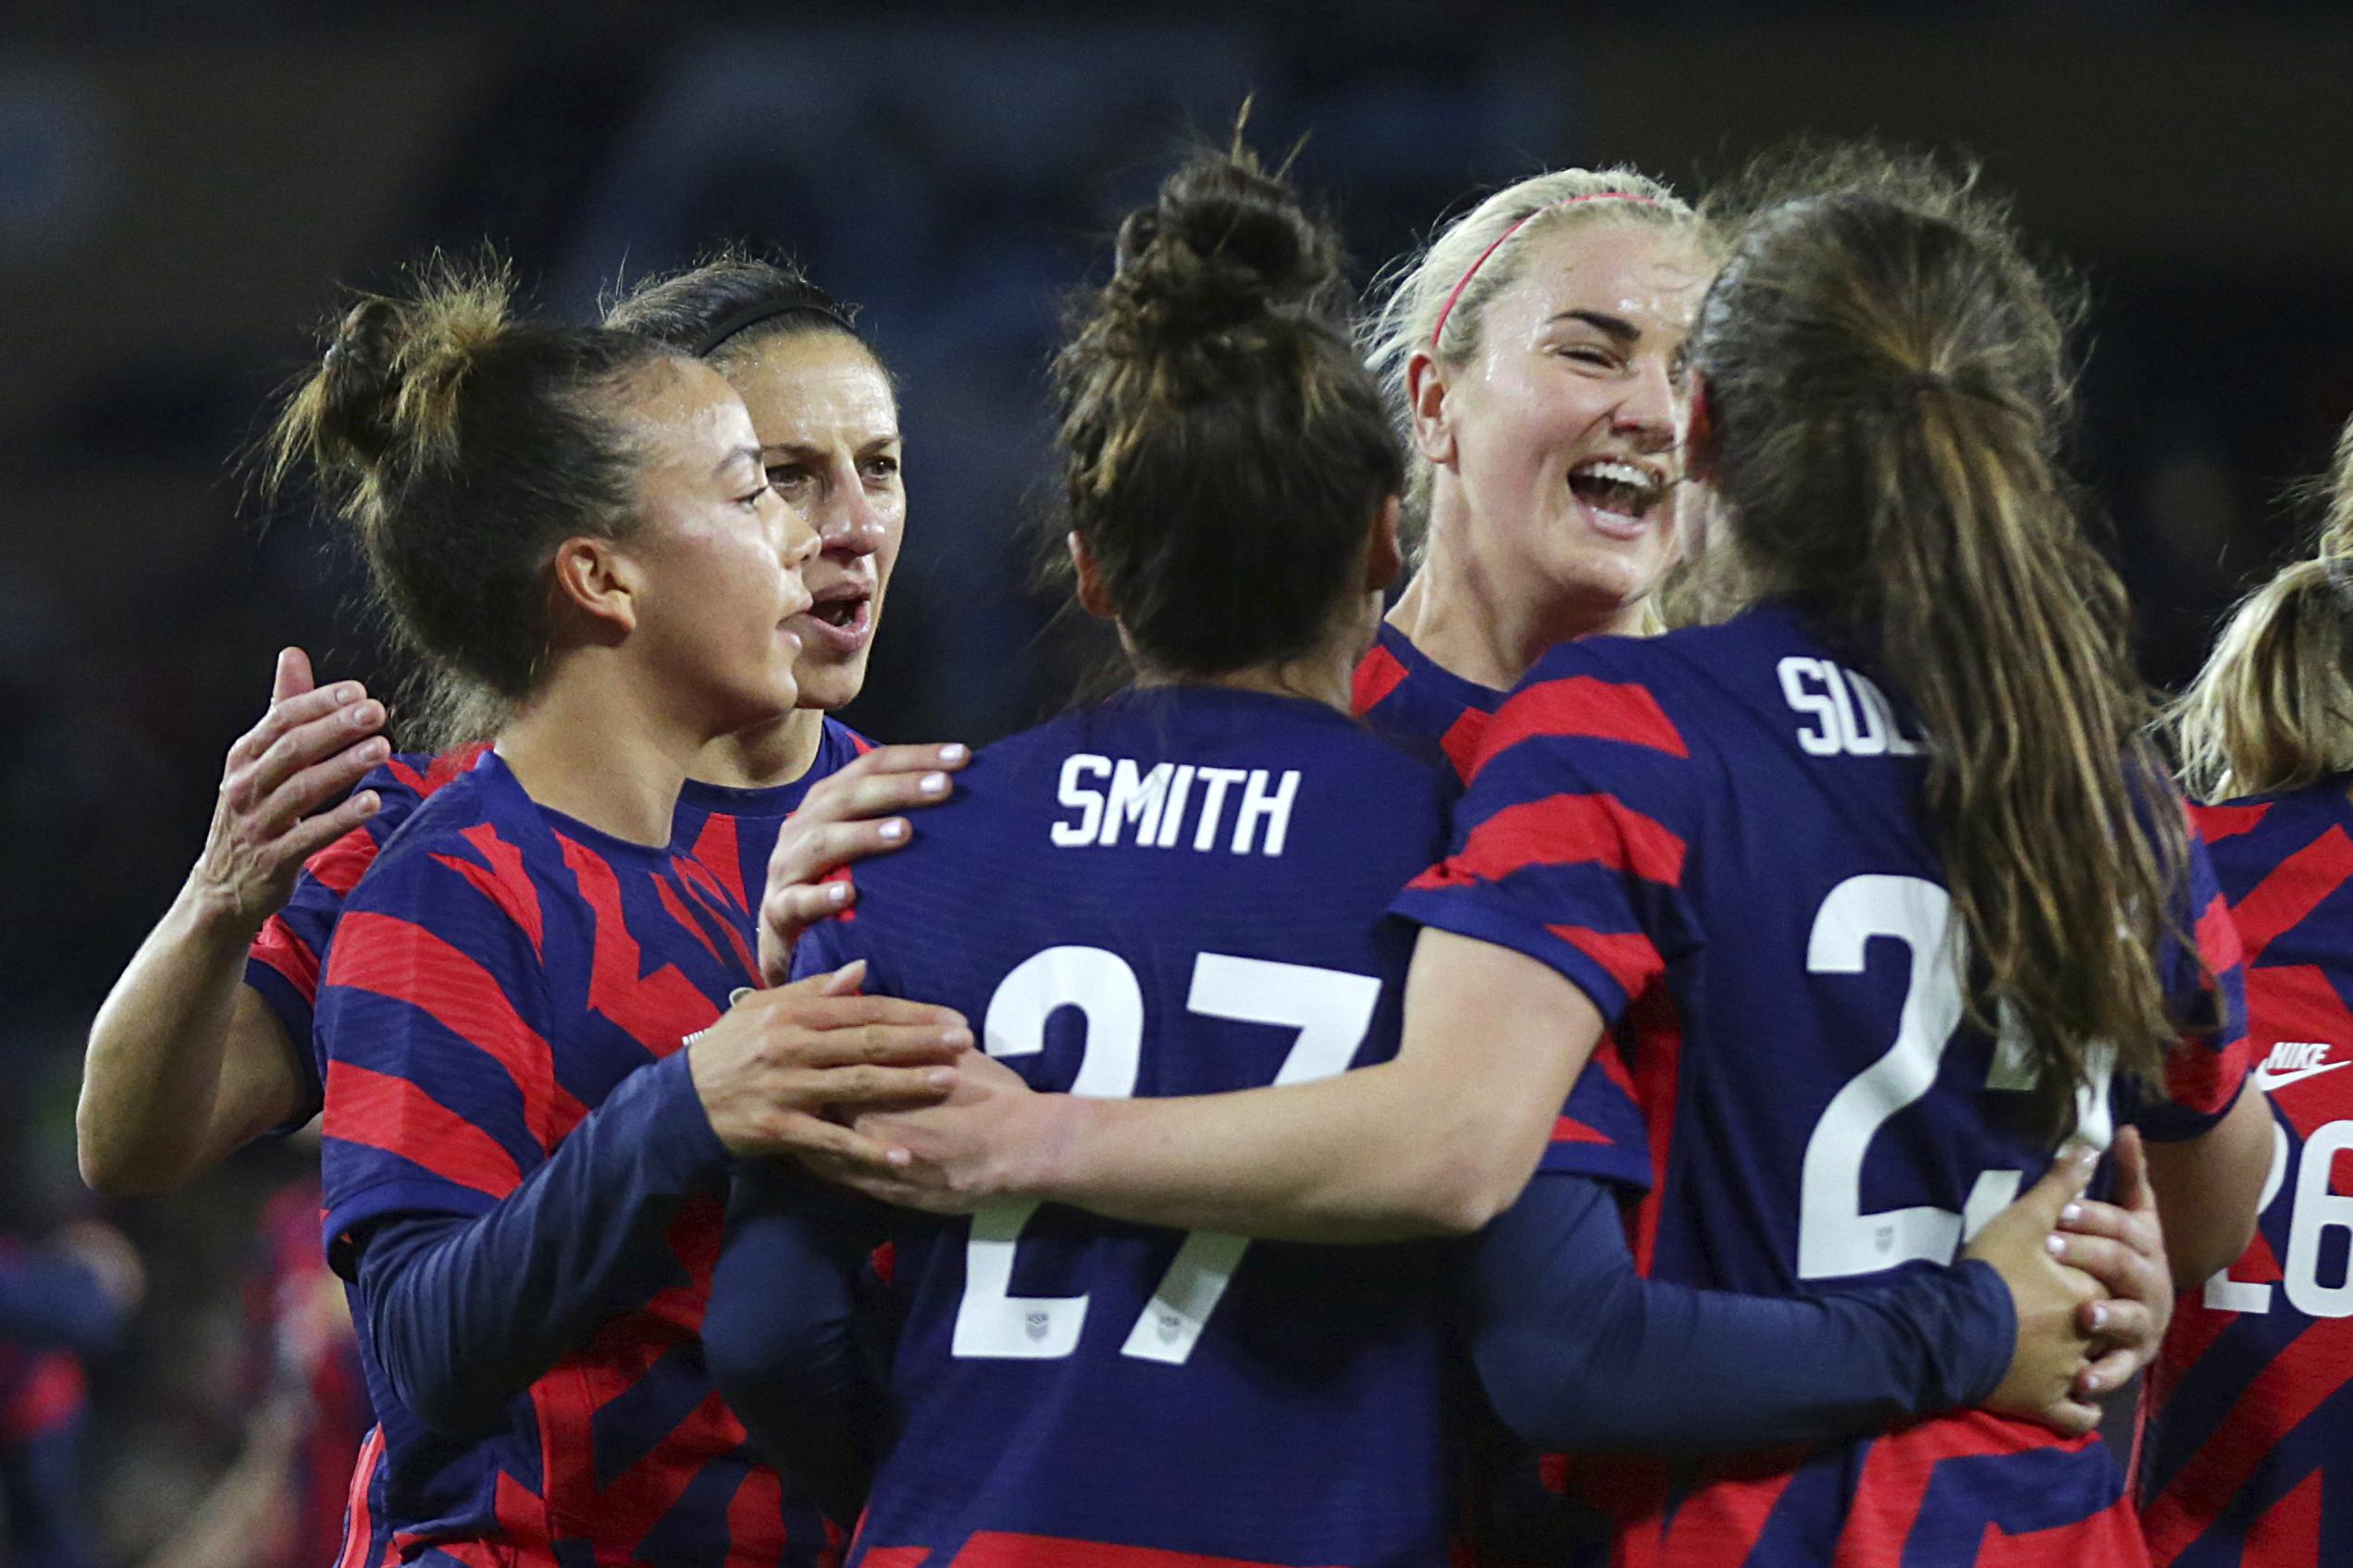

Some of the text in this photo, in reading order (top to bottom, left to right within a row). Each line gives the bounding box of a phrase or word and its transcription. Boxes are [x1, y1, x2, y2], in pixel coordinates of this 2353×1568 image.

[1777, 656, 1919, 756] SUL
[1050, 754, 1300, 856] SMITH
[2266, 1042, 2331, 1069] NIKE
[951, 945, 1381, 1364] 27
